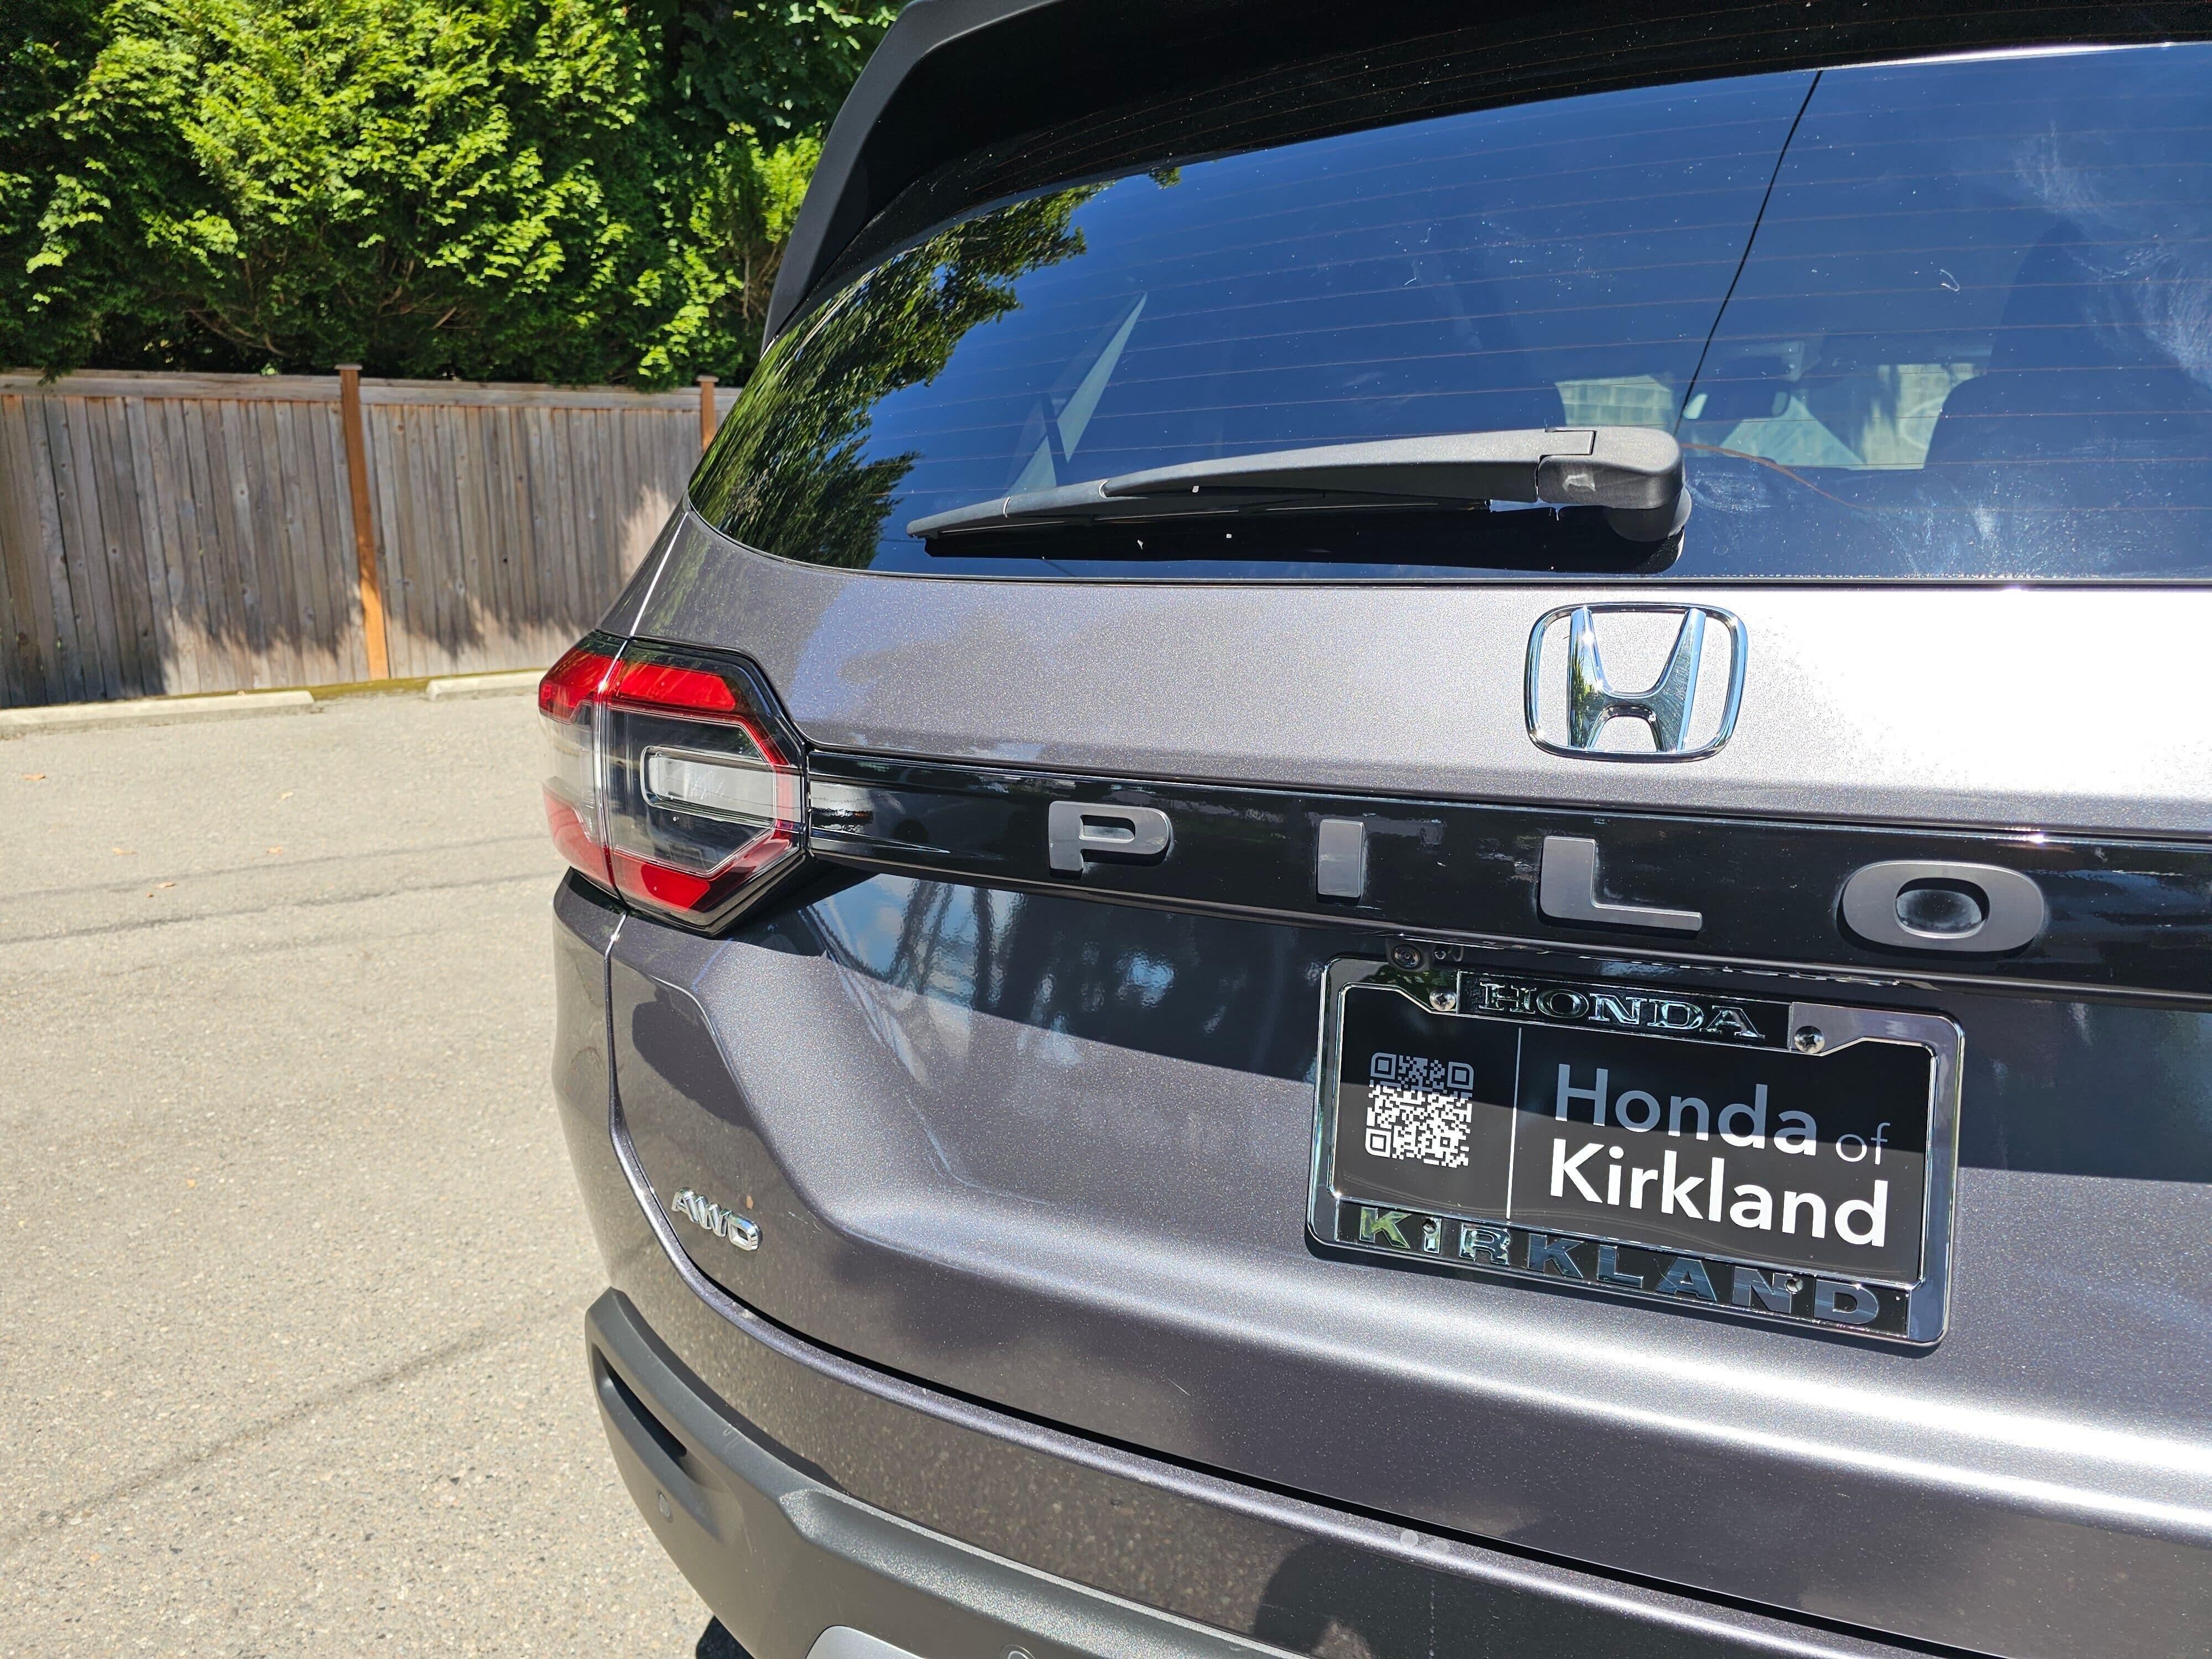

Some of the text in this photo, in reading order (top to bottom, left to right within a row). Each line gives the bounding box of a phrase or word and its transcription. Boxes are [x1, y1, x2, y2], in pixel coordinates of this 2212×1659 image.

[1048, 800, 2046, 953] PILO
[1478, 980, 1766, 1040] HONDA
[1554, 1063, 1891, 1165] Honda of
[671, 1187, 762, 1251] AWD
[1550, 1138, 1888, 1248] Kirkland
[1359, 1207, 1880, 1325] KIRKLAND
